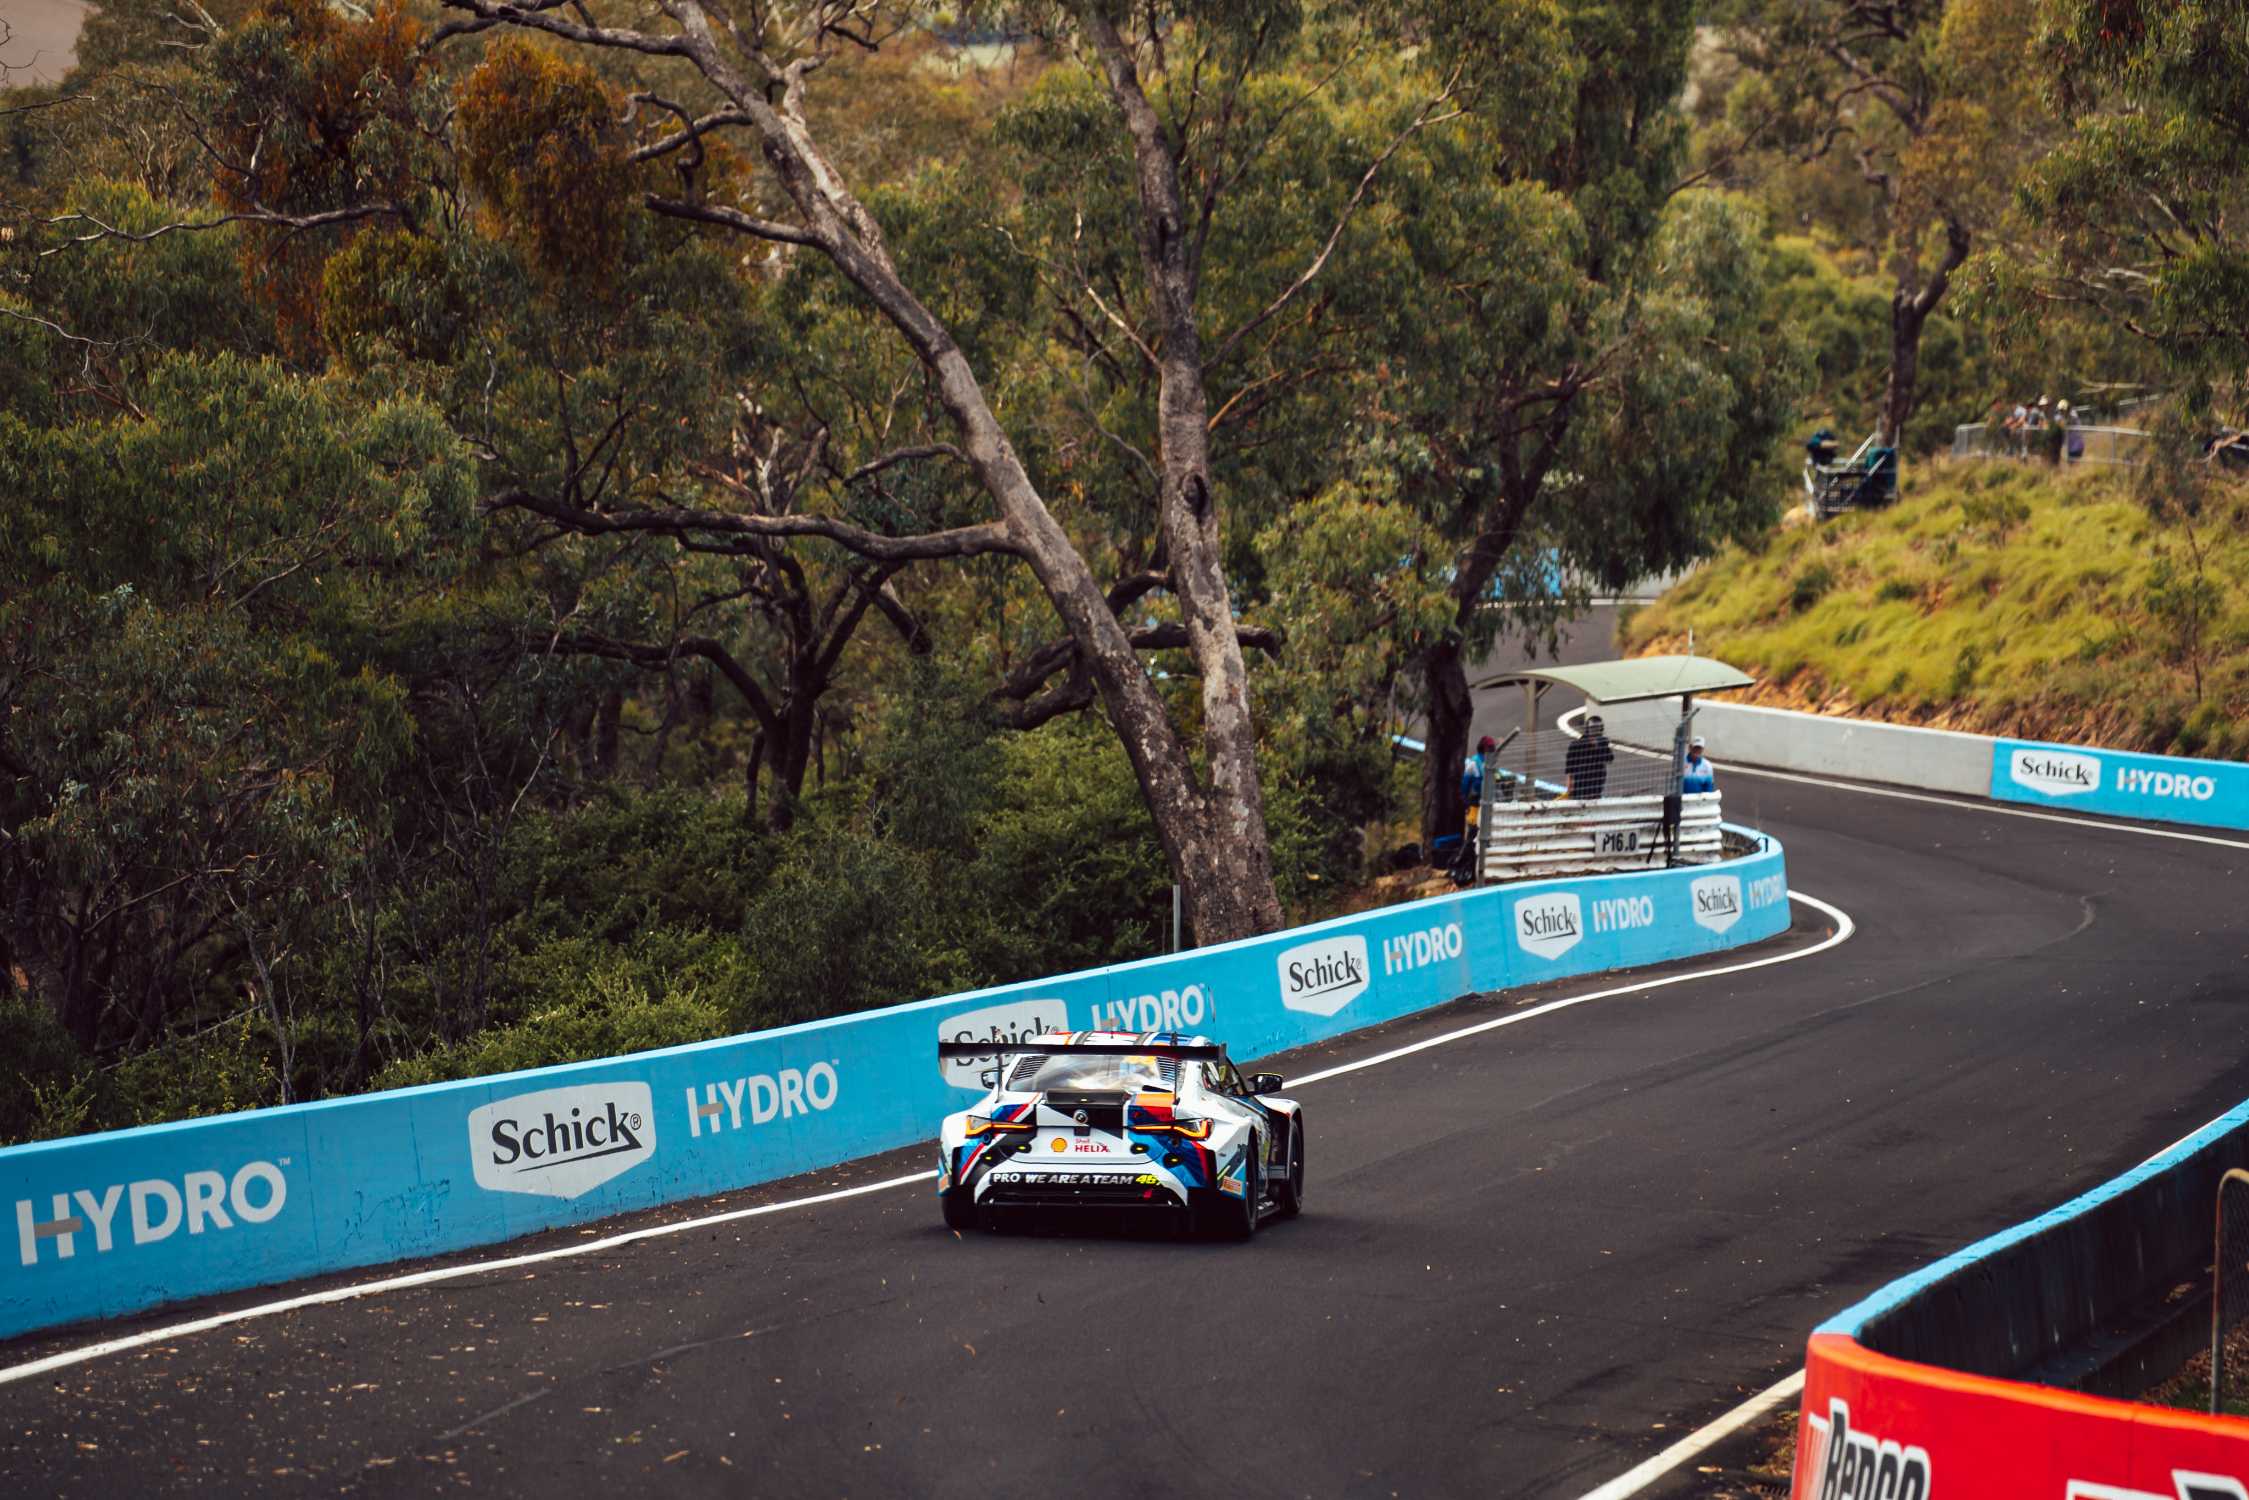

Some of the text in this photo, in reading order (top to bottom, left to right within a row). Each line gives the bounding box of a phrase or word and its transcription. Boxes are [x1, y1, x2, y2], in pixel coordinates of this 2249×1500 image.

[2020, 756, 2216, 800] Schick HYDRO
[1522, 896, 1654, 937] Schick HYDRO
[1075, 1144, 1109, 1152] HELIX
[993, 1173, 1021, 1183] PRO
[1025, 1174, 1046, 1184] WE
[1049, 1174, 1078, 1184] ARE
